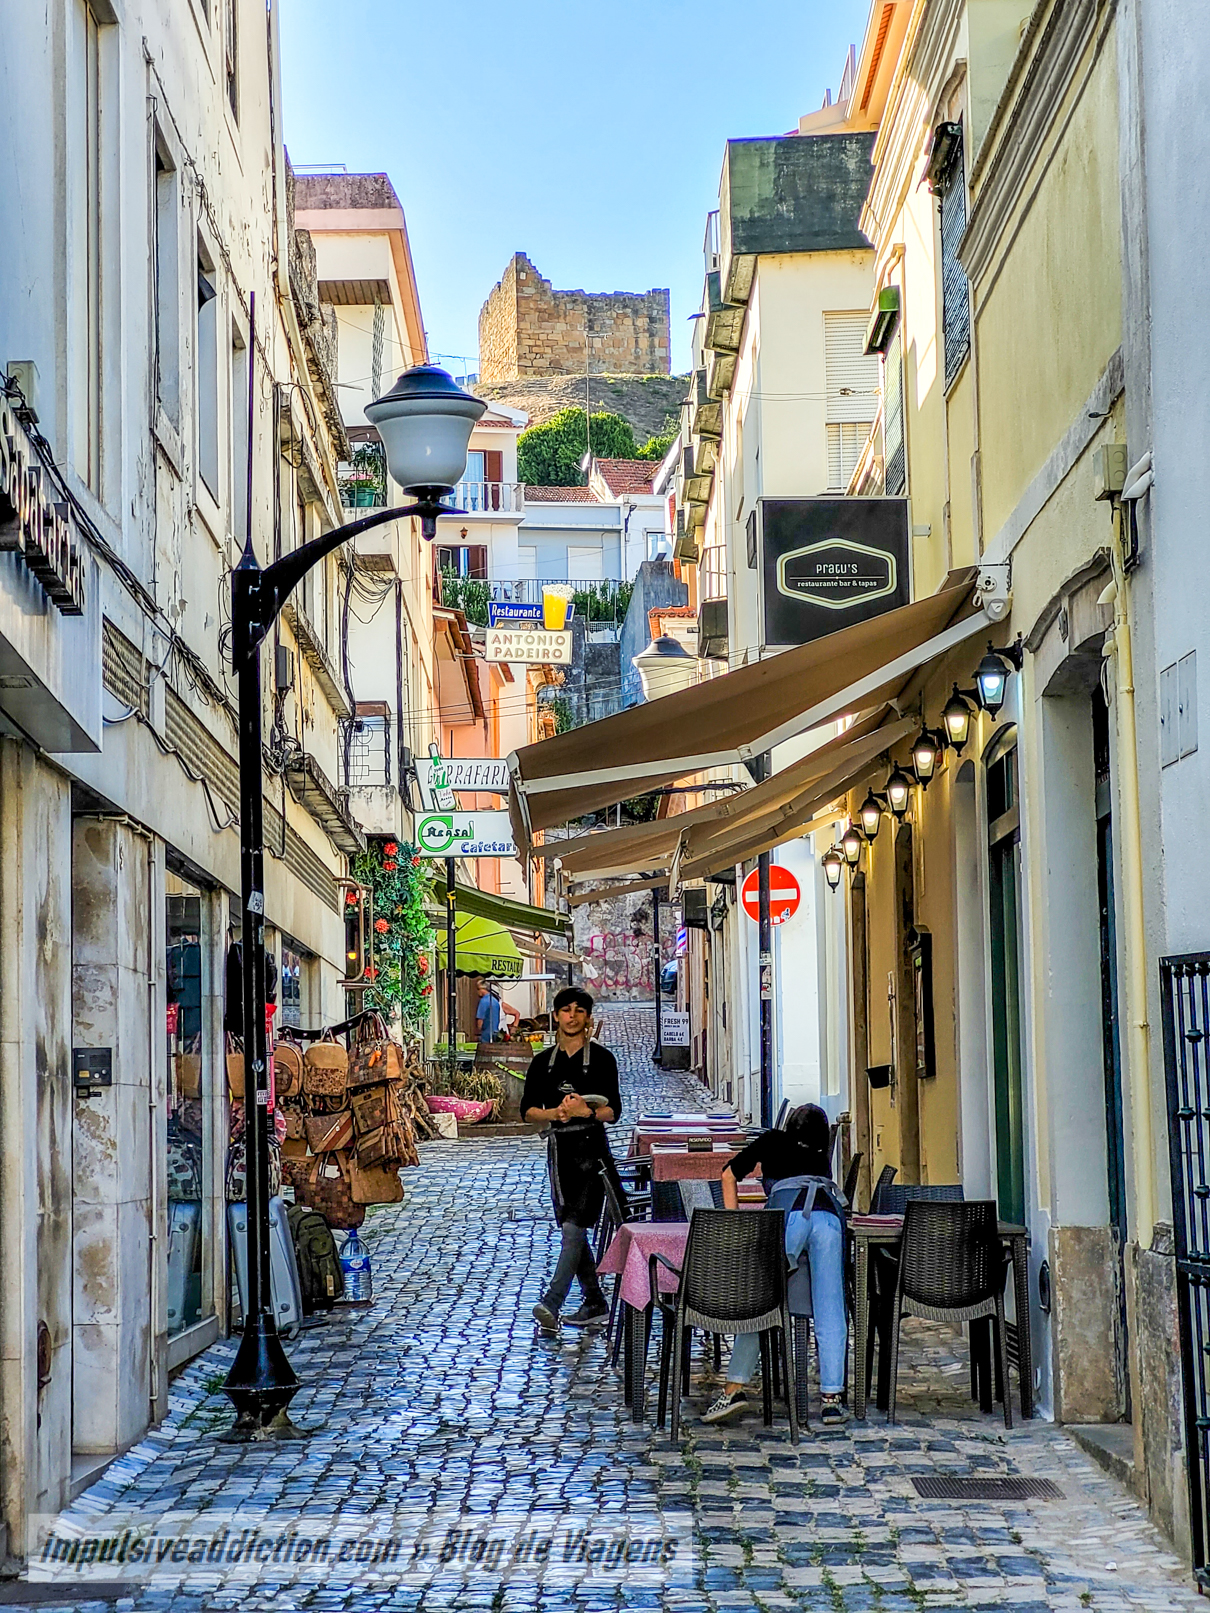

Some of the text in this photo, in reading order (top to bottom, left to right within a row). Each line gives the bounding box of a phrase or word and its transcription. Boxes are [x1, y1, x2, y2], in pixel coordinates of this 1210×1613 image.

[491, 604, 541, 618] Restaurante
[493, 646, 563, 659] PADEIRO
[461, 841, 517, 854] Cafetari
